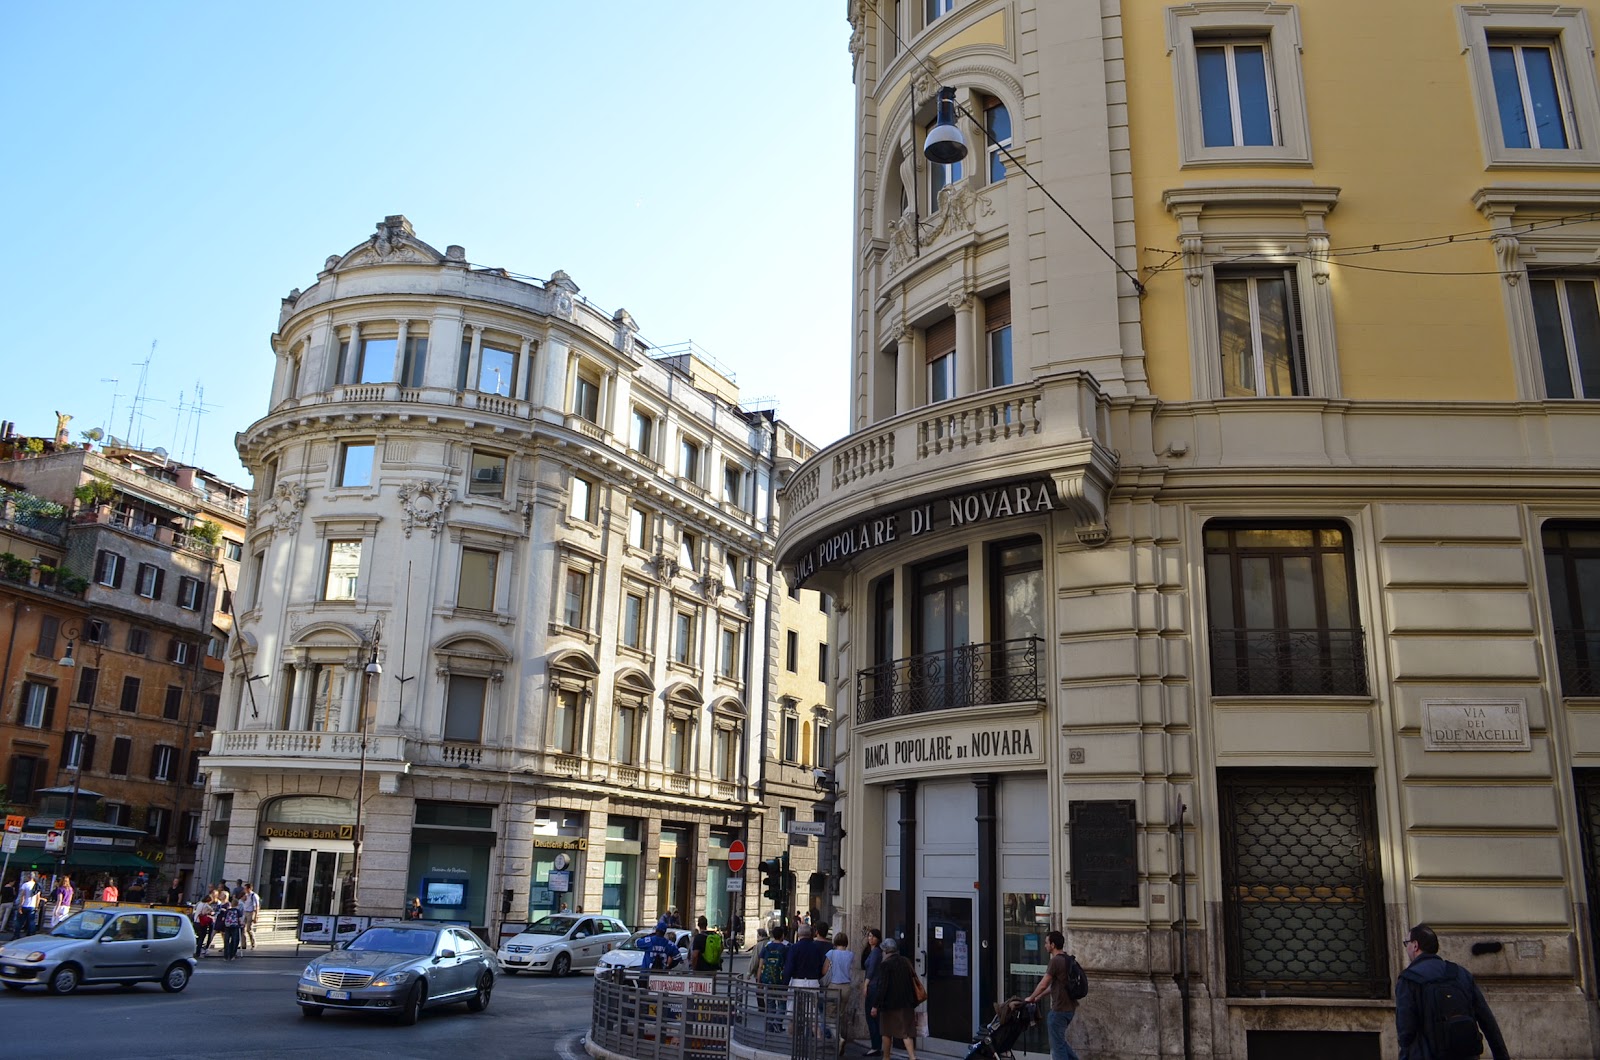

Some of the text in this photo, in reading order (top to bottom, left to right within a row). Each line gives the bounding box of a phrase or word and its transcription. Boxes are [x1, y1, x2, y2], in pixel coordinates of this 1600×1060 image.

[794, 484, 1054, 588] ANCA POPOLARE DI NOVARA
[1463, 708, 1486, 718] VIA
[1467, 720, 1485, 728] DEI
[1435, 729, 1519, 740] DUE MACELLI
[865, 729, 1033, 769] BANCA POPOLARE DI NOVARA
[1070, 750, 1082, 761] 69
[6, 819, 22, 827] TAXI
[266, 827, 337, 838] Deutsche Bank
[534, 839, 562, 849] Deutsche
[650, 979, 712, 994] SOTTOPASSAGGIO PEDONALE
